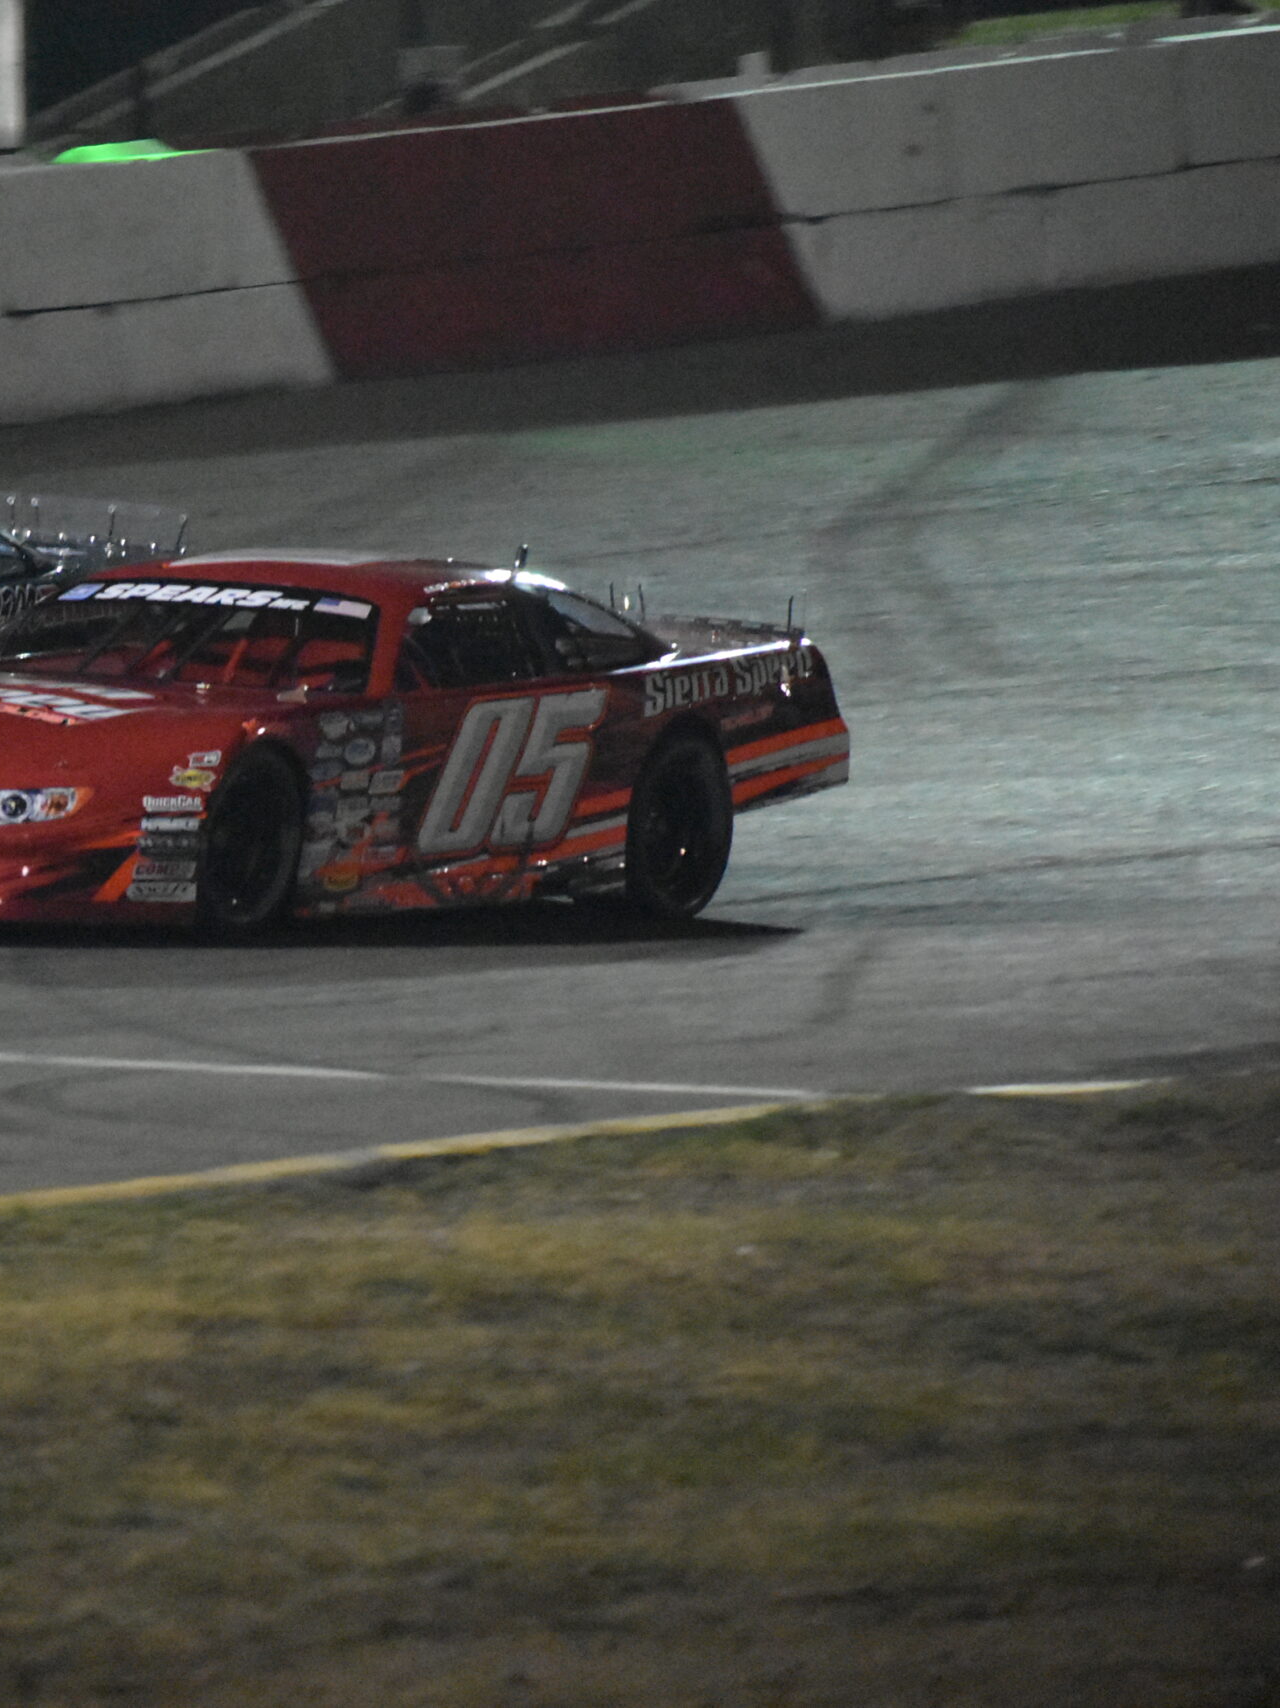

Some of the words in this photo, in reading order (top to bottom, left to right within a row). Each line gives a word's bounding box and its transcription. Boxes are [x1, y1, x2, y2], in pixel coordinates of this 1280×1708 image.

[95, 583, 284, 607] SPEARS
[644, 666, 730, 718] Sierra
[418, 688, 609, 853] 05
